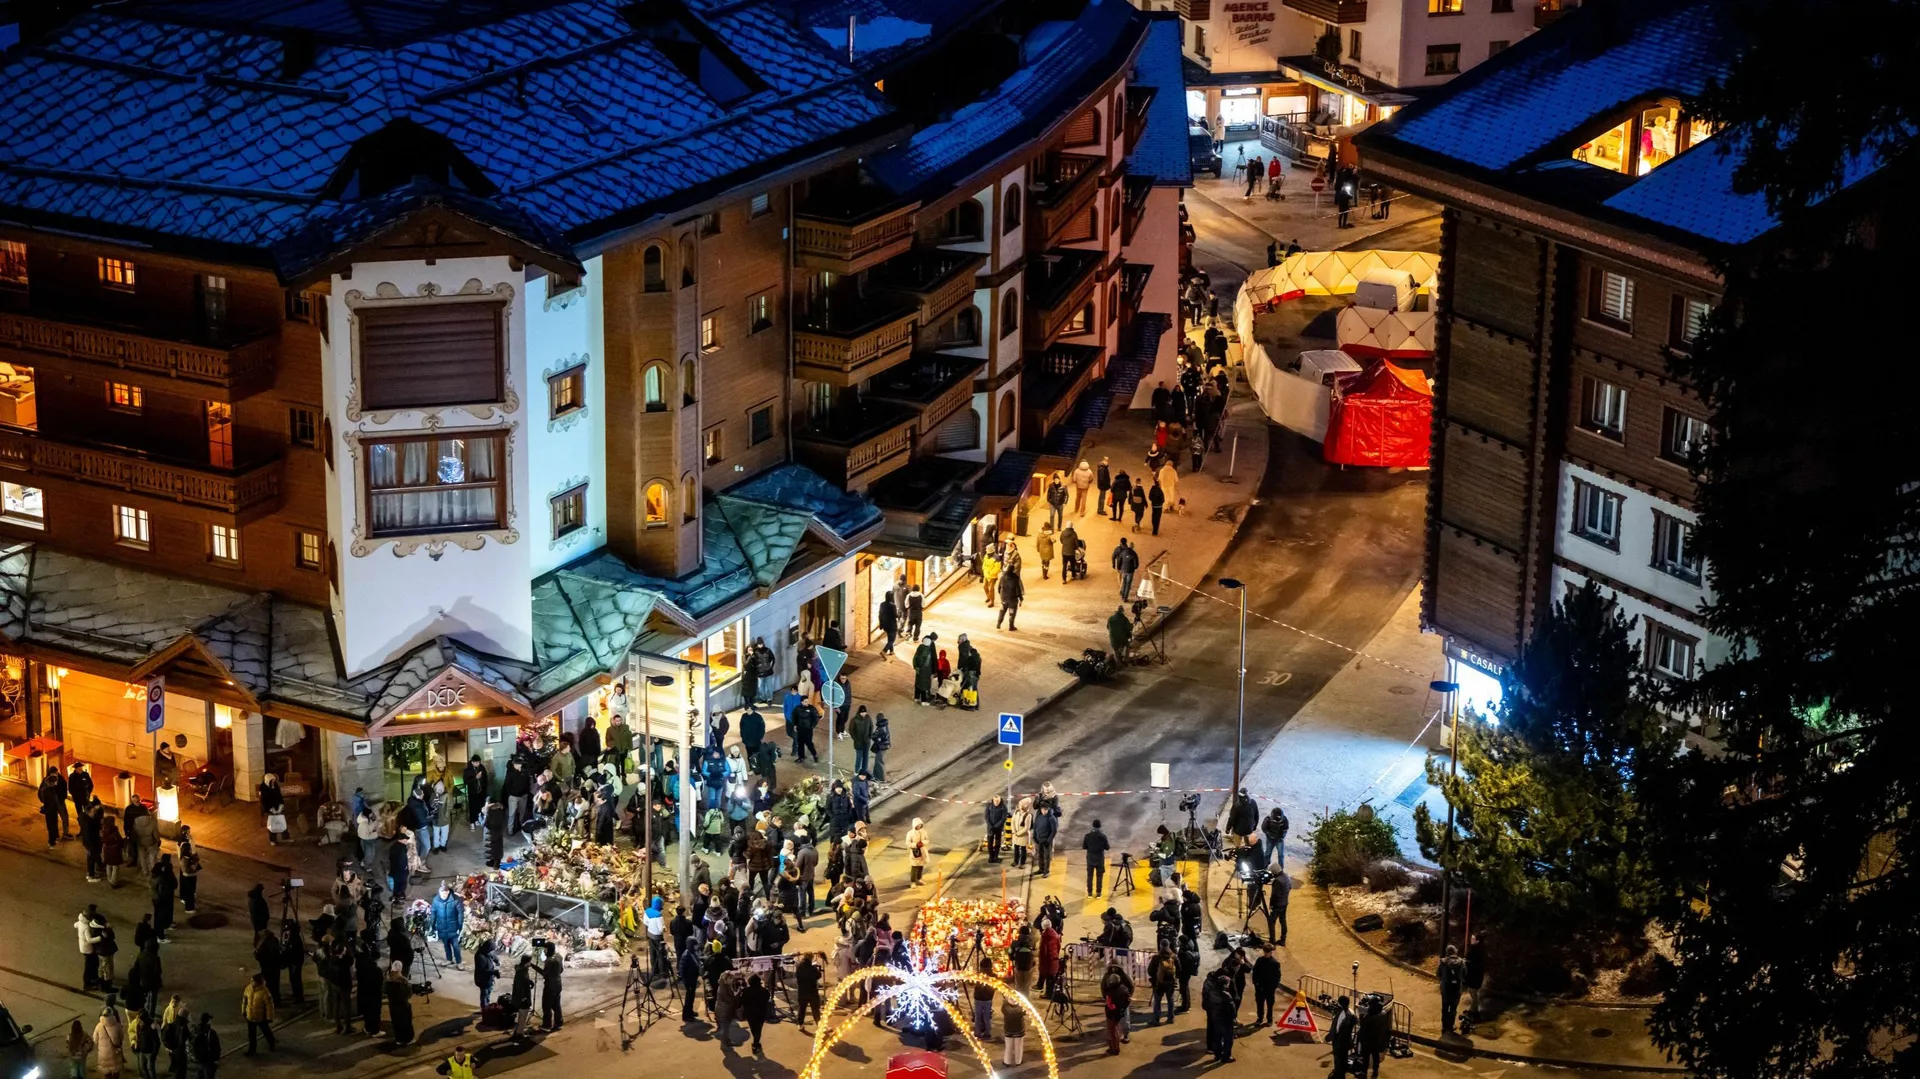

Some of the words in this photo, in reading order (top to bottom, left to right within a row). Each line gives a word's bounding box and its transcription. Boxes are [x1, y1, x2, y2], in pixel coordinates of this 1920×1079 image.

[1223, 2, 1269, 12] AGENCE
[1232, 13, 1276, 23] BARRAS
[1256, 671, 1293, 686] 30
[1287, 1016, 1310, 1026] Police
